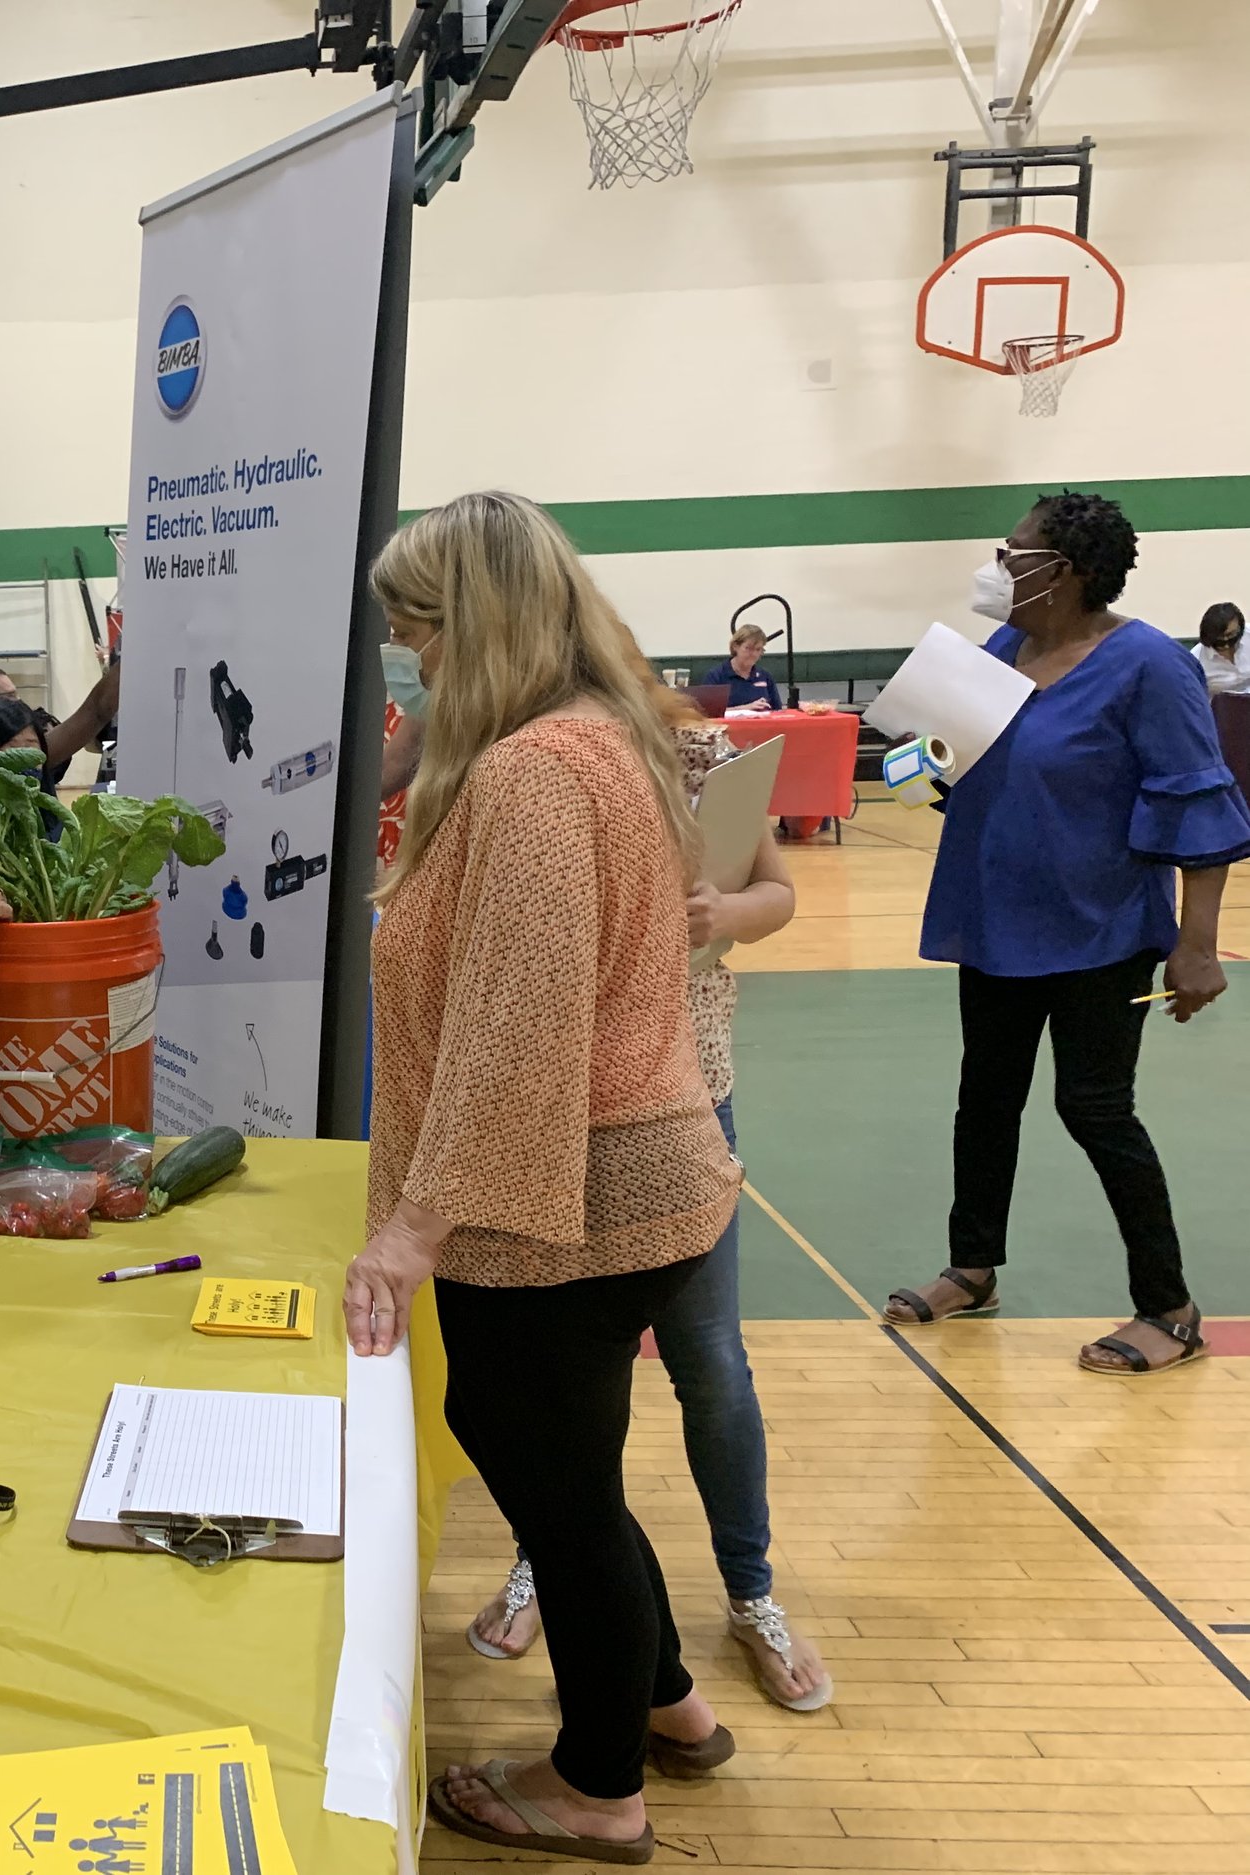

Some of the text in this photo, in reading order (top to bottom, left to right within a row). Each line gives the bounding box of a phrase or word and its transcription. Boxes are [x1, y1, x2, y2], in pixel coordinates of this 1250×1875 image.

[157, 339, 200, 373] BIMBA
[147, 448, 322, 502] Pneumatic. Hydraulic.
[146, 505, 279, 541] Electric. Vacuum.
[144, 548, 238, 580] We Have it All.
[154, 1053, 187, 1078] plications
[158, 1035, 189, 1060] Solutions
[189, 1051, 199, 1065] for
[34, 1072, 112, 1137] EPOT
[243, 1090, 293, 1129] We make
[107, 1442, 119, 1462] Streets
[112, 1433, 121, 1444] Are
[102, 1462, 114, 1479] These
